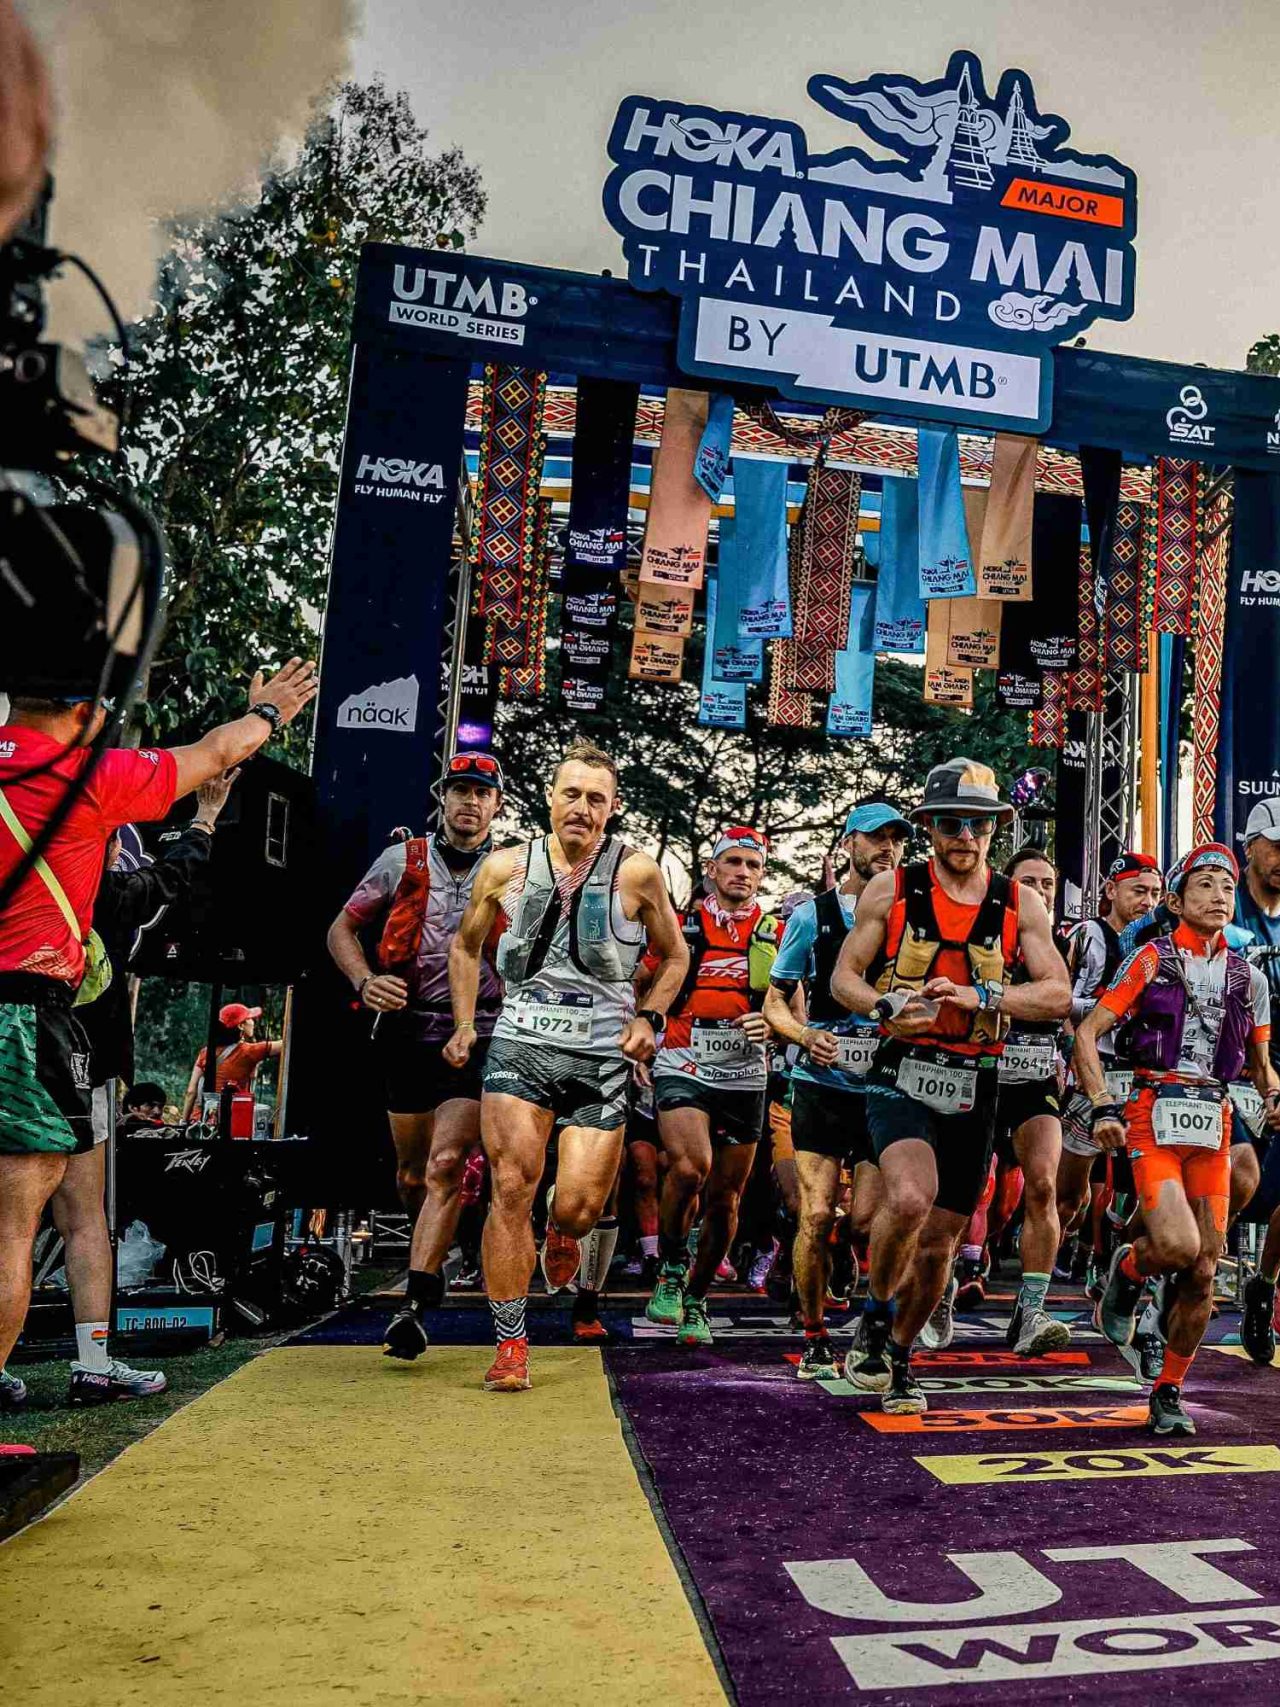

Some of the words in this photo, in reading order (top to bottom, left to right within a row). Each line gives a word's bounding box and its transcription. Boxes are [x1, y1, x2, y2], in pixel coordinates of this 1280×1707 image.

[623, 107, 797, 177] HOKA
[1016, 186, 1100, 217] MAJOR
[619, 169, 950, 272] CHIANG
[970, 225, 1124, 306] MAI
[392, 264, 529, 318] UTMB
[637, 244, 962, 323] THAILAND
[396, 306, 460, 327] WORLD
[466, 321, 519, 341] SERIES
[727, 313, 788, 357] BY
[854, 344, 997, 399] UTMB
[1169, 422, 1216, 441] SAT
[355, 454, 445, 489] HOKA
[354, 484, 374, 495] FLY
[376, 487, 420, 501] HUMAN
[423, 493, 443, 504] FLY
[569, 538, 604, 550] CHIANG
[604, 541, 623, 550] MAI
[647, 555, 681, 568] CHIANG
[682, 561, 700, 569] MAI
[983, 565, 1002, 573] HOKA
[921, 573, 951, 583] CHIANG
[953, 570, 969, 580] MAI
[983, 572, 1011, 581] CHIANG
[1012, 574, 1027, 582] MAI
[1240, 597, 1256, 606] FLY
[951, 642, 981, 650] CHIANG
[347, 702, 409, 725] näak
[532, 1015, 573, 1033] 1972
[705, 1039, 741, 1052] 1006
[844, 1050, 874, 1062] 101
[1004, 1056, 1038, 1069] 1964
[703, 1066, 760, 1080] alpenplus
[917, 1077, 956, 1098] 1019
[1165, 1100, 1203, 1109] ELEPHANT
[1170, 1112, 1213, 1131] 1007
[82, 1373, 109, 1386] HOKA
[919, 1409, 1126, 1428] 50K
[978, 1451, 1253, 1476] 20K
